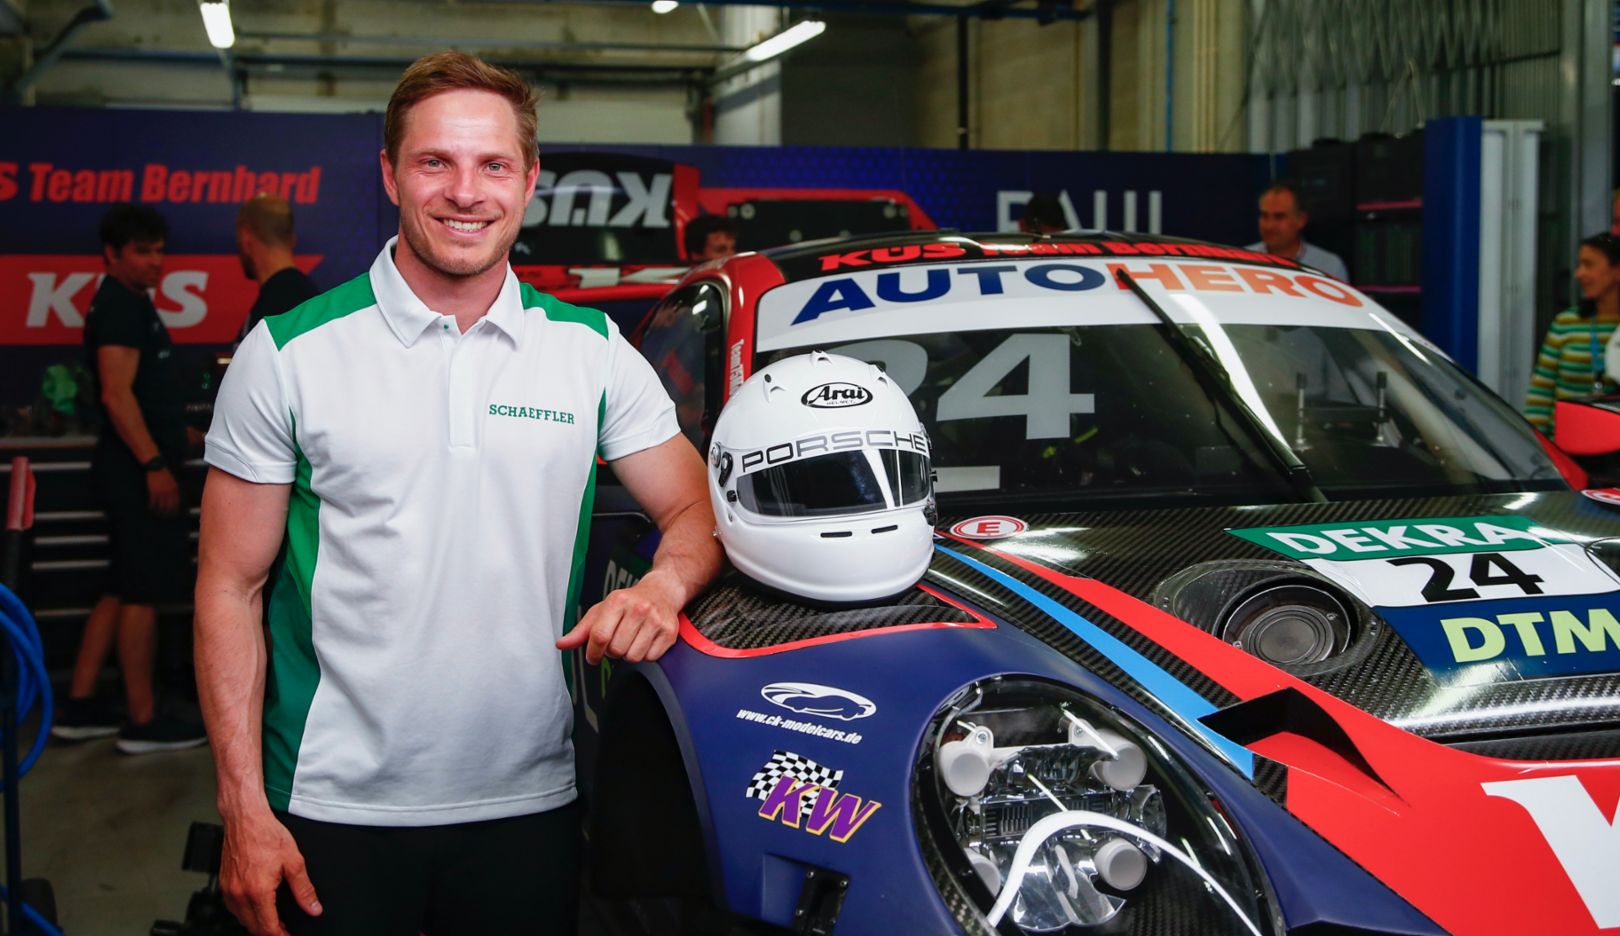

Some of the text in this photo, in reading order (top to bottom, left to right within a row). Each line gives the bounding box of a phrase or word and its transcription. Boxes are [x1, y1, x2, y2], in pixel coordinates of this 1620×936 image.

[29, 163, 134, 203] Team
[140, 163, 322, 204] Bernhard
[26, 270, 209, 328] KS
[790, 262, 1364, 326] AUTOHERO
[488, 404, 575, 424] SCHAEFFLER
[807, 385, 866, 405] Arai
[742, 431, 929, 472] PORSCHE
[976, 522, 1001, 534] E
[1266, 522, 1541, 555] DEKRA
[1386, 552, 1545, 603] 24
[1440, 608, 1620, 663] DTM
[736, 709, 863, 745] www.ck-modelcars.de
[758, 775, 882, 843] KW
